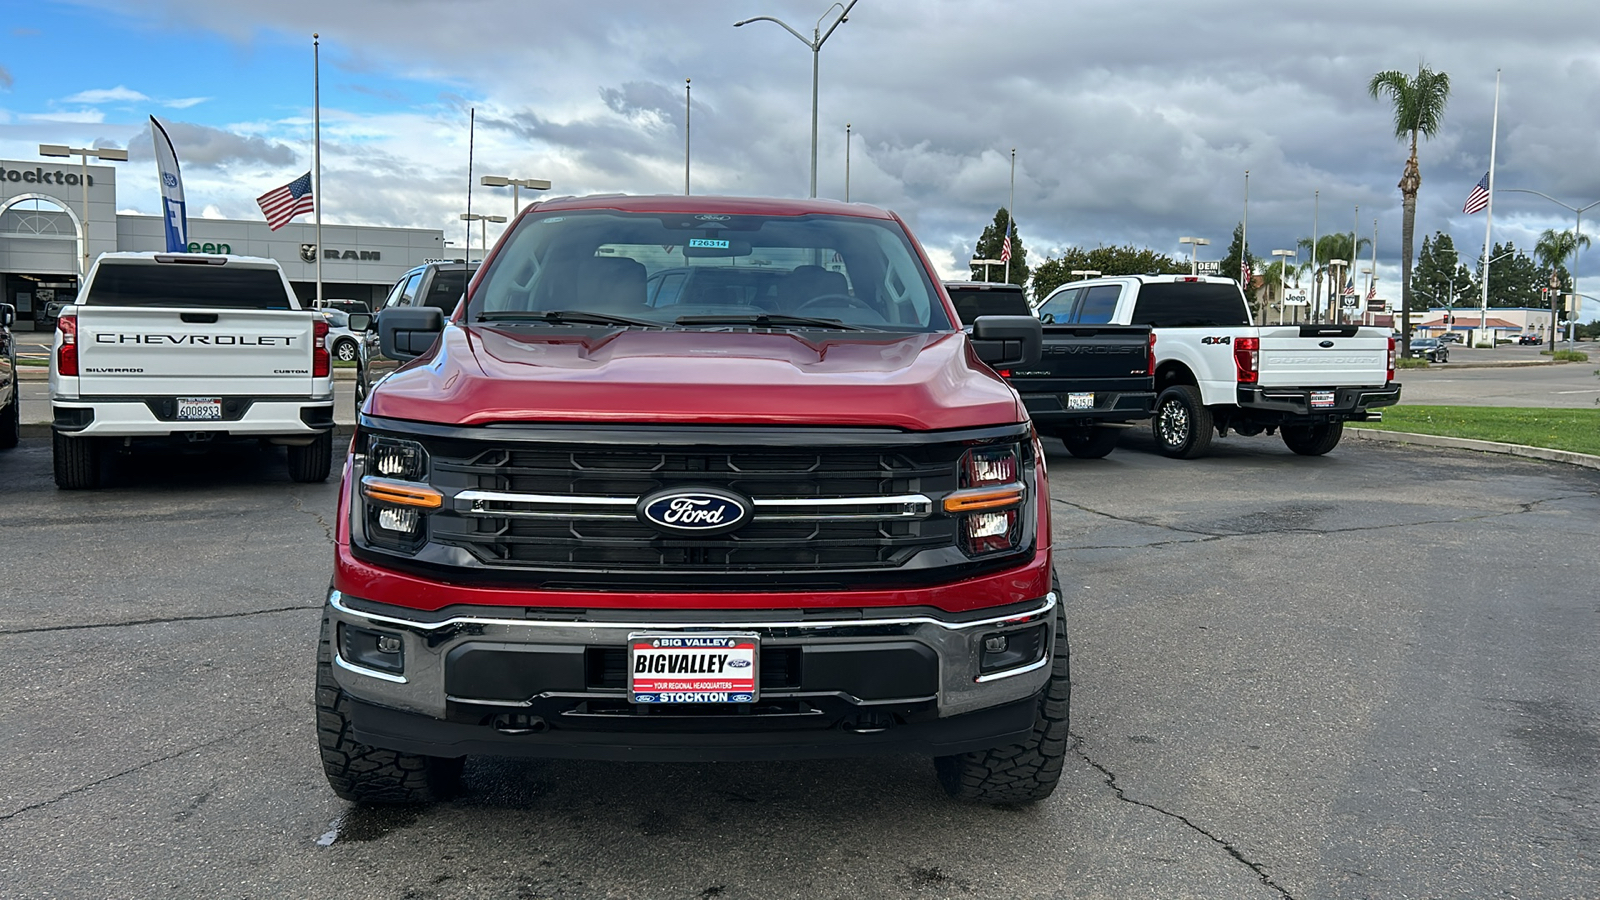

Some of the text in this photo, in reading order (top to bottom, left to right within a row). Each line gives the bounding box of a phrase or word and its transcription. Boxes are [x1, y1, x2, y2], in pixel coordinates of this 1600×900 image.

[0, 167, 94, 187] tockton
[187, 241, 231, 254] eep
[323, 249, 381, 261] RAM
[1197, 262, 1218, 270] OEM
[1285, 294, 1306, 303] Jeep
[95, 333, 297, 346] CHEVROLET
[1041, 345, 1143, 354] HEVROLET
[1269, 357, 1331, 365] SUPER
[180, 406, 220, 416] 60089S3
[663, 498, 726, 524] Ford
[685, 639, 728, 647] VALLEY
[634, 654, 729, 674] BIGVALLEY
[659, 692, 728, 702] STOCKTON
